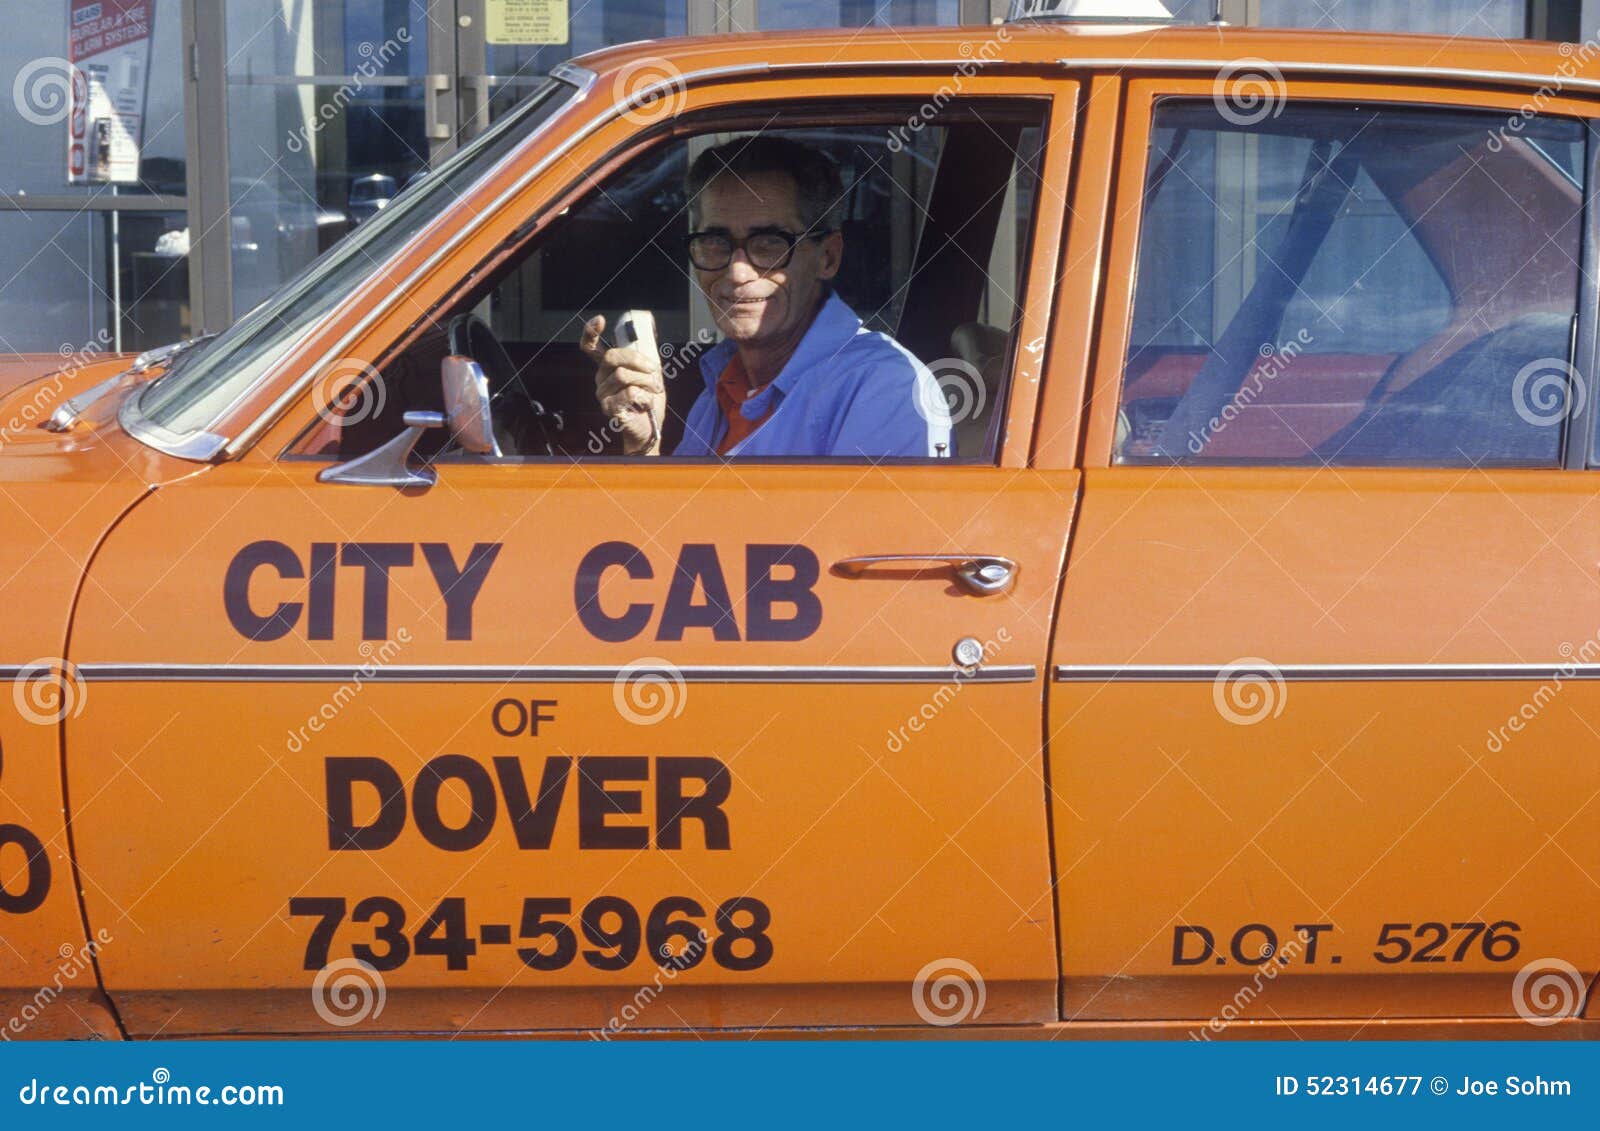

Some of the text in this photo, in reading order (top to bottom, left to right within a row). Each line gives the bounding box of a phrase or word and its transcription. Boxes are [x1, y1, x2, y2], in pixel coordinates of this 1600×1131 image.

[224, 541, 822, 643] CITY CAB
[493, 699, 557, 736] OF
[325, 755, 731, 851] DOVER
[290, 896, 774, 972] 734-5968
[1172, 921, 1521, 966] D.O.T. 5276
